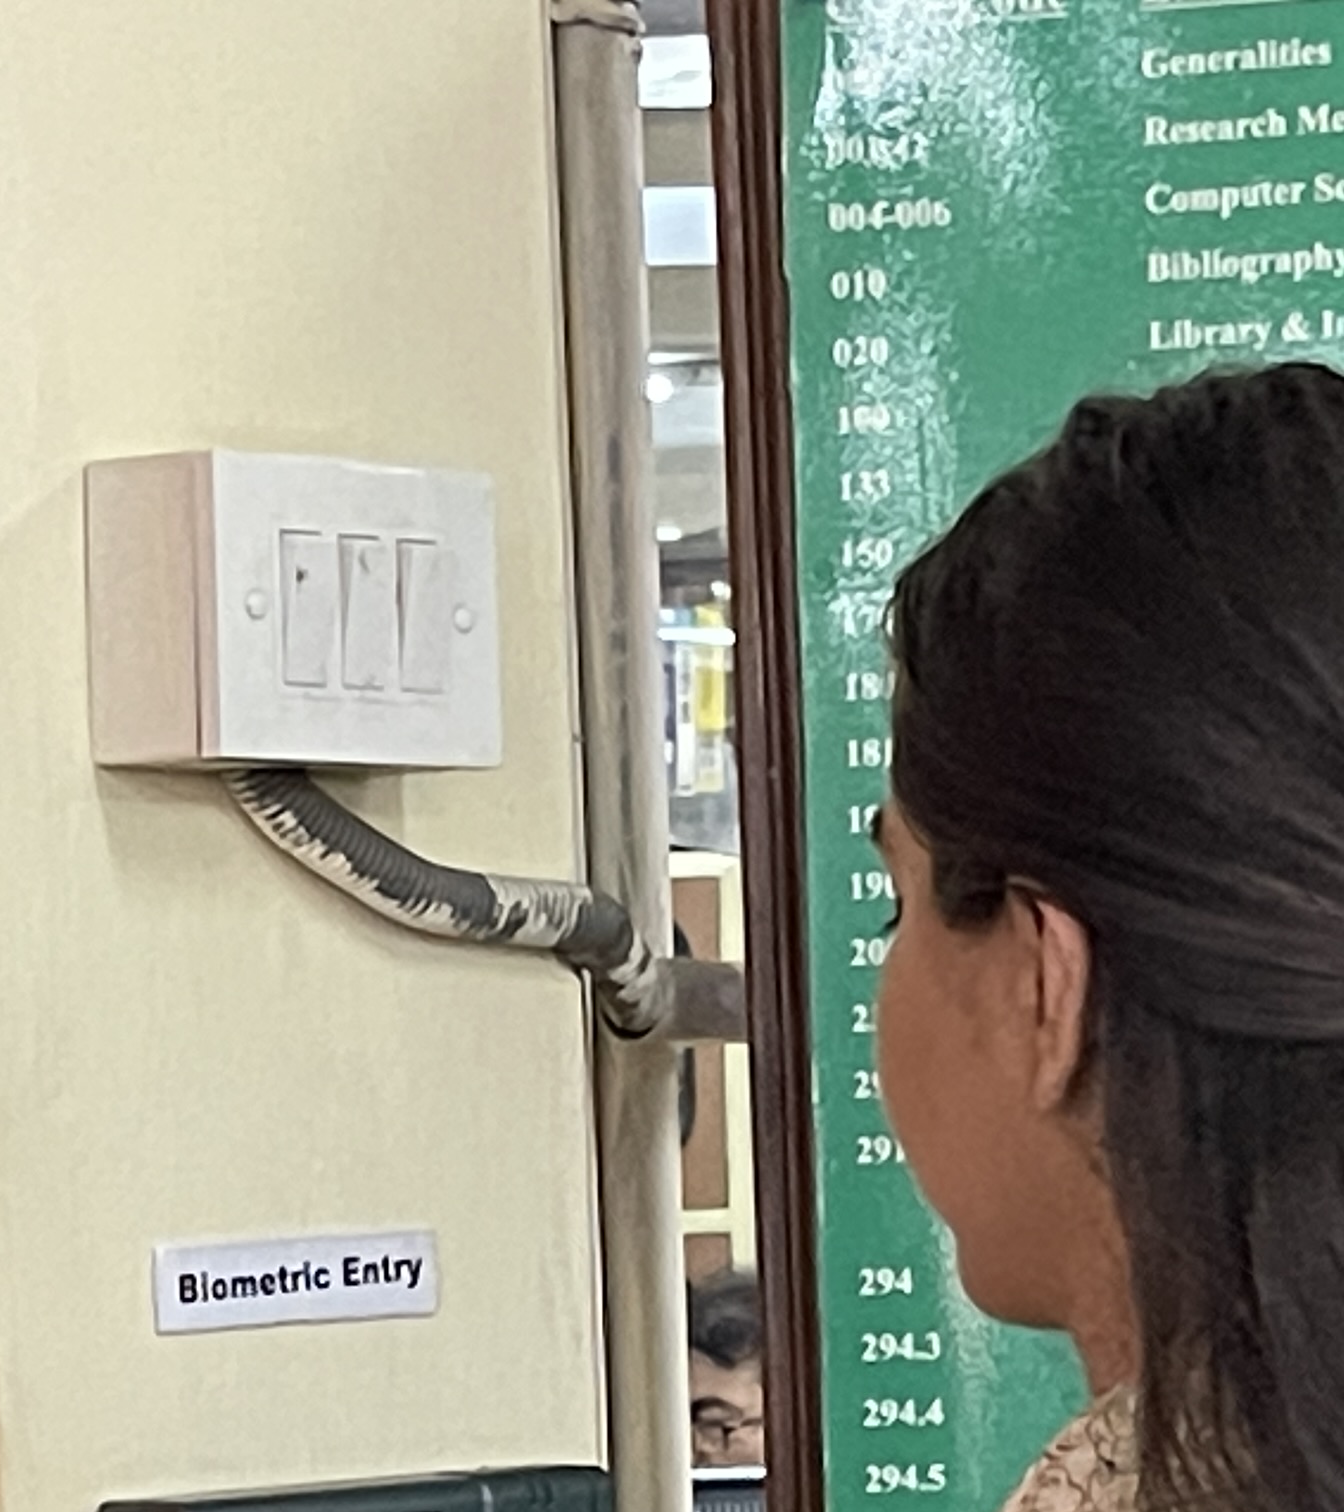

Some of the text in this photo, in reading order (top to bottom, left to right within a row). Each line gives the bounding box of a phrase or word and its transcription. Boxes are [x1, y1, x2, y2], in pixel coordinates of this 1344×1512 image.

[1141, 37, 1332, 79] Generalities
[1143, 108, 1287, 146] Research
[828, 196, 952, 232] 004-006
[1144, 181, 1307, 220] Computer
[830, 264, 890, 301] 010
[1150, 319, 1272, 358] Library
[1281, 311, 1311, 343] &
[832, 336, 889, 368] 020
[841, 469, 891, 501] 133
[850, 937, 895, 967] 20
[179, 1255, 423, 1304] Biometric Entry
[859, 1267, 913, 1296] 294
[861, 1331, 941, 1362] 294.3
[863, 1397, 945, 1427] 294.4
[865, 1463, 946, 1493] 294.5
